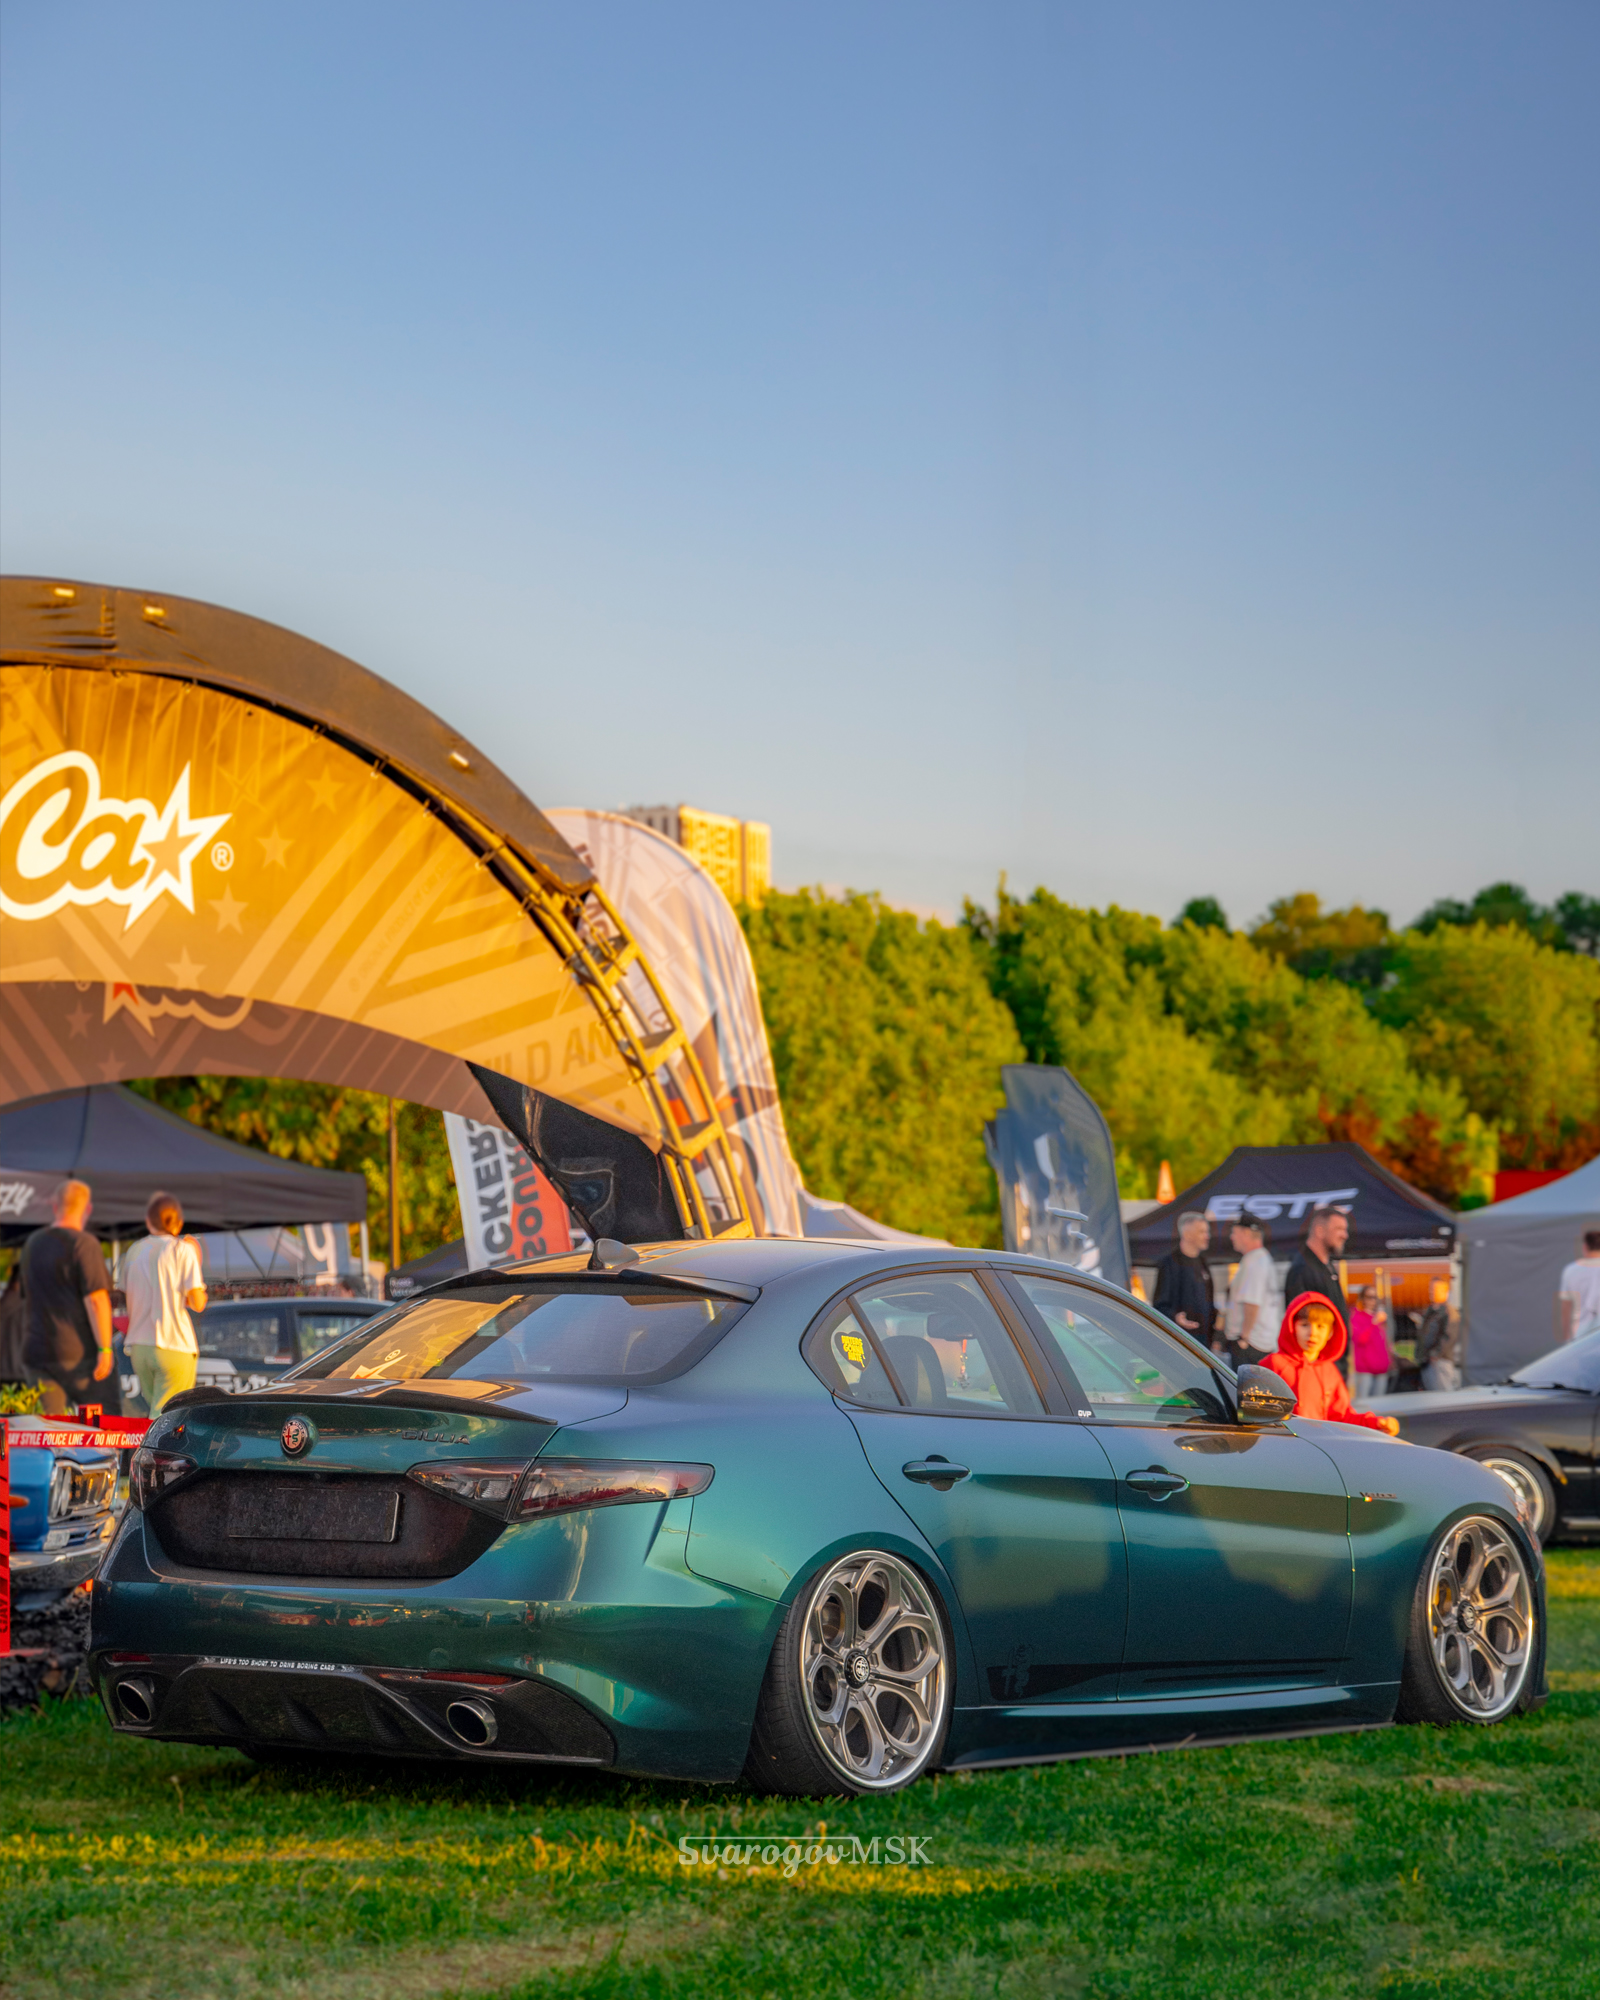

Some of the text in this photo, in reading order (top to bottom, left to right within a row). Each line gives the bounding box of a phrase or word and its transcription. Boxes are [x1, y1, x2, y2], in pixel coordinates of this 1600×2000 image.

[1206, 1188, 1360, 1222] EST
[20, 1432, 42, 1446] STYLE
[42, 1432, 67, 1446] POLICE
[68, 1433, 83, 1446] LINE
[94, 1434, 104, 1446] DO
[106, 1434, 120, 1446] NOT
[121, 1434, 144, 1446] CROSS
[402, 1430, 470, 1445] GIULIA
[297, 1662, 318, 1670] BORING
